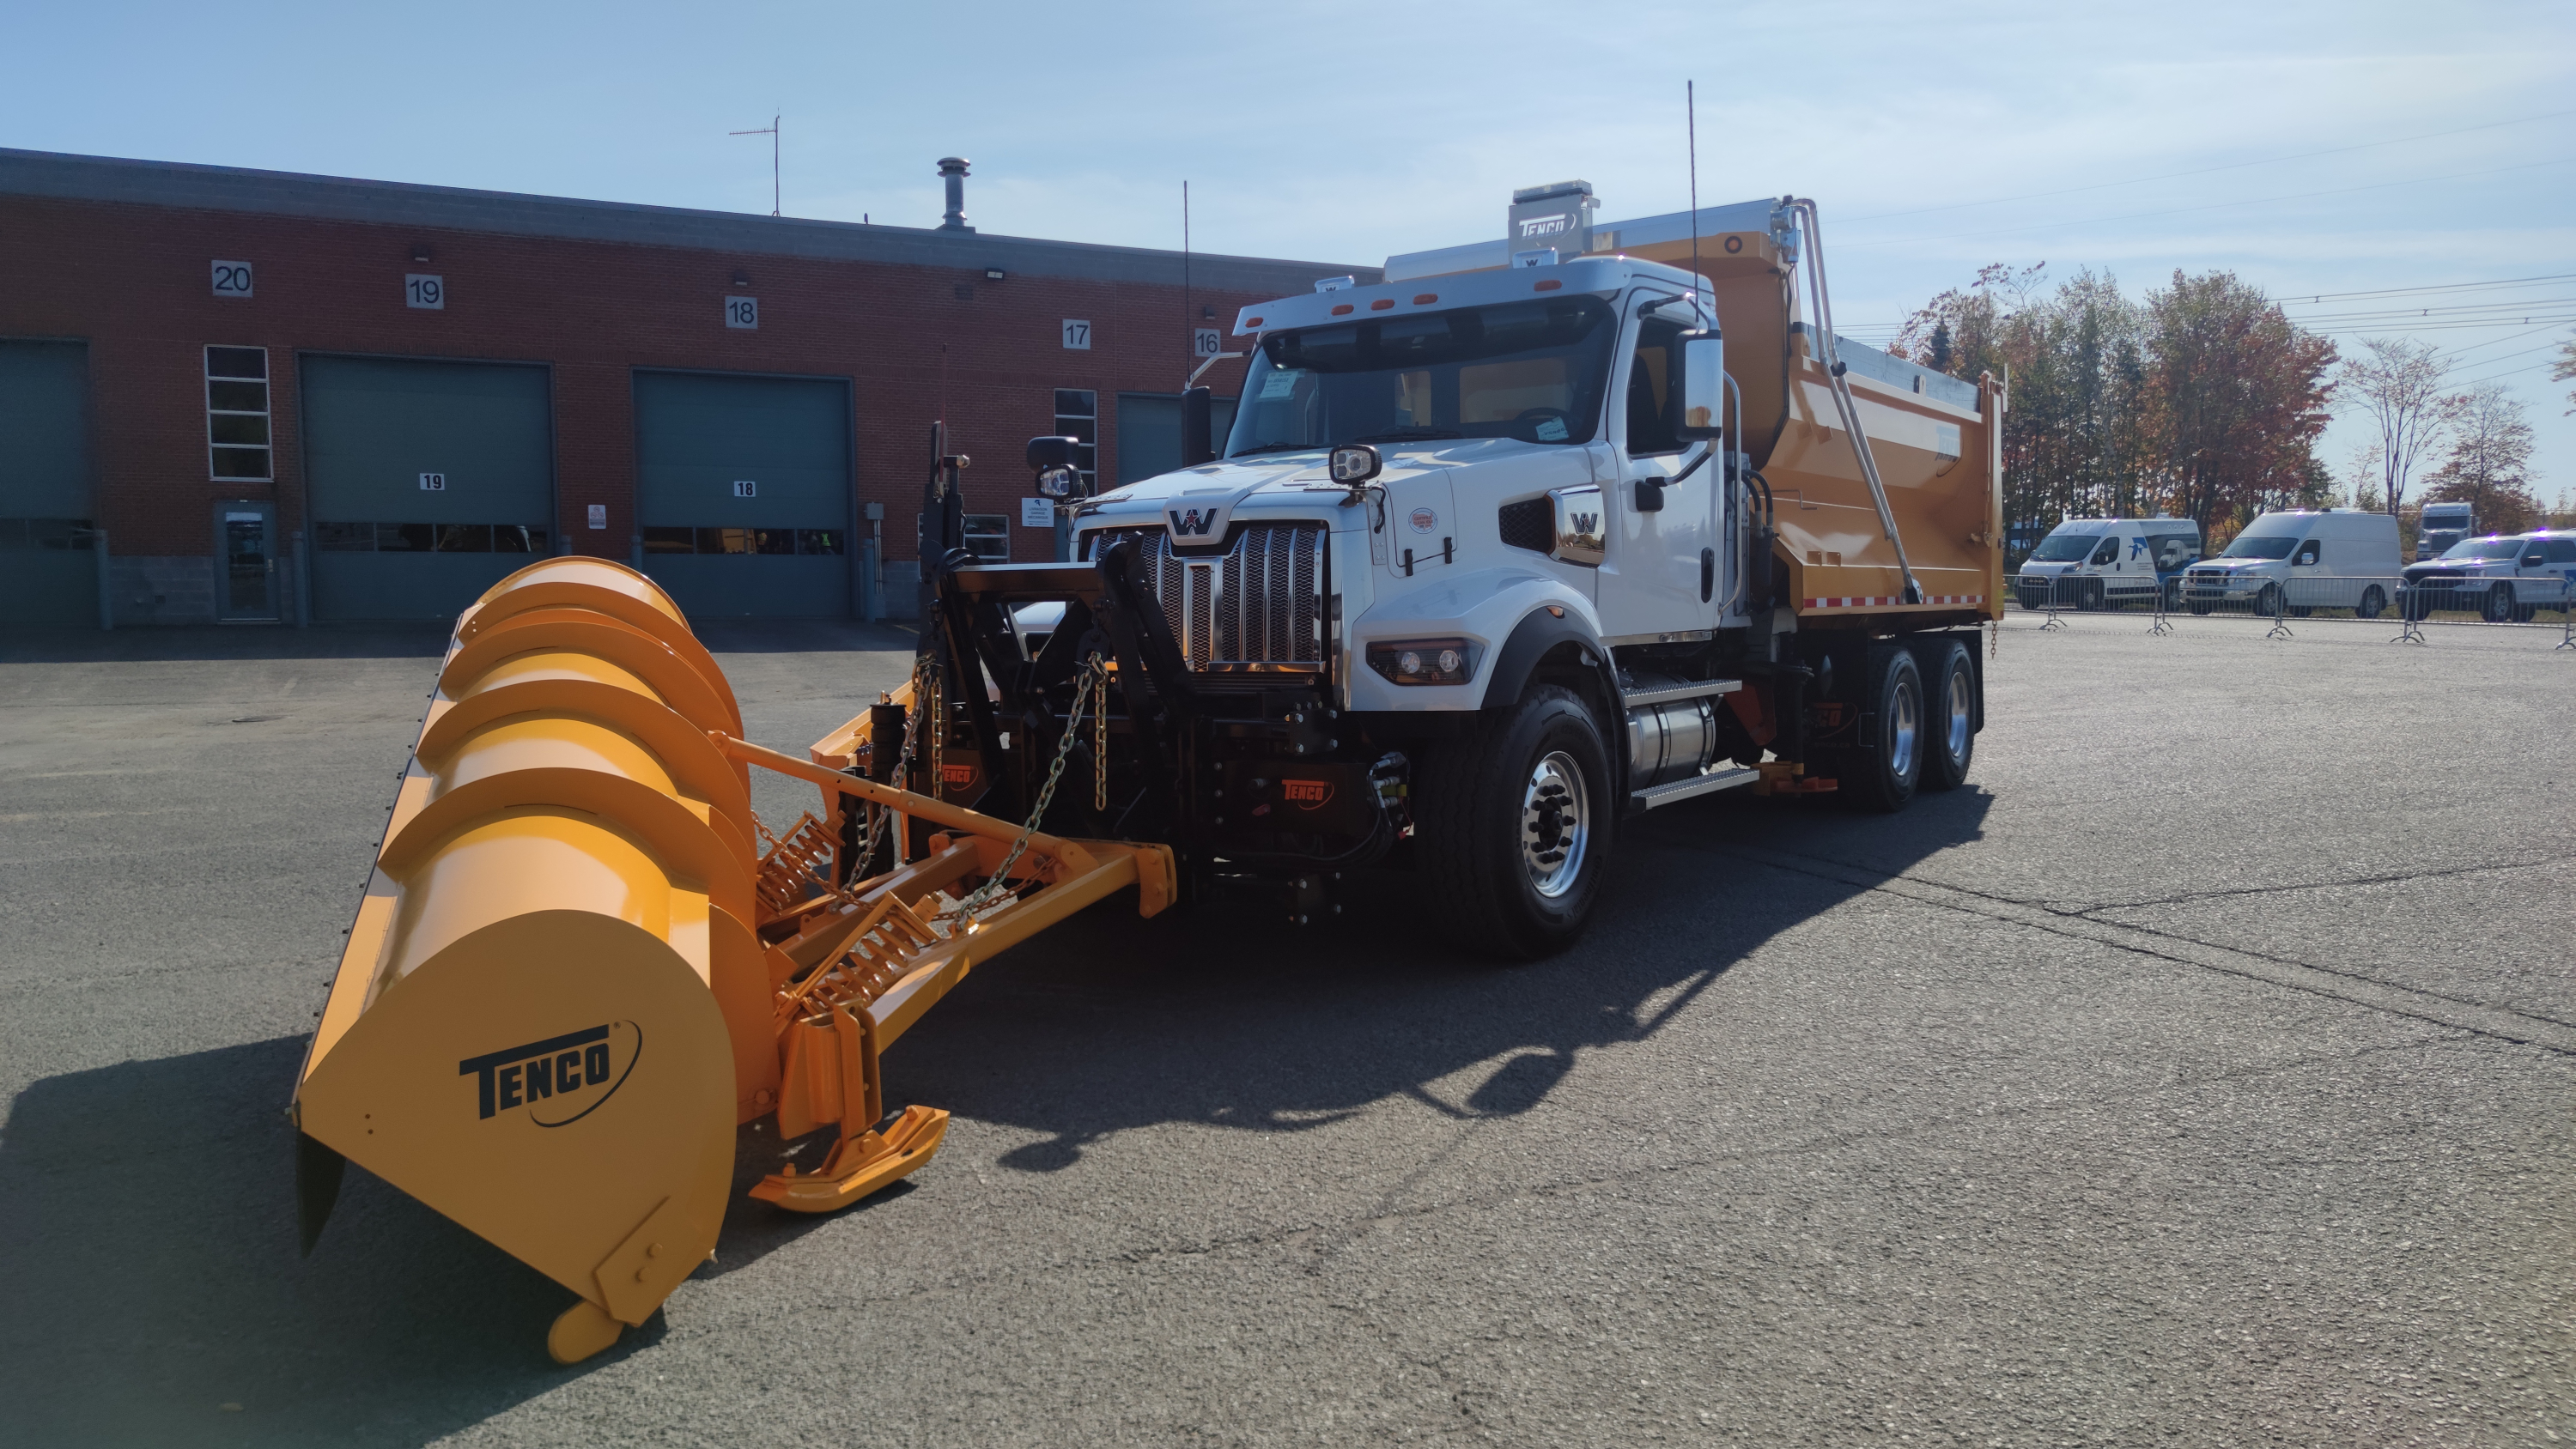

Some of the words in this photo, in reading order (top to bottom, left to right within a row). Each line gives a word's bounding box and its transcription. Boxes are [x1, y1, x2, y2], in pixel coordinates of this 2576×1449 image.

[1519, 213, 1565, 240] TENCO
[215, 266, 251, 292] 20
[410, 280, 440, 304] 19
[729, 301, 755, 324] 18
[1066, 324, 1089, 345] 17
[1197, 332, 1218, 354] 16
[423, 475, 442, 489] 19
[738, 482, 753, 496] 18
[1281, 779, 1325, 800] TENCO
[459, 1024, 611, 1120] TENCO
